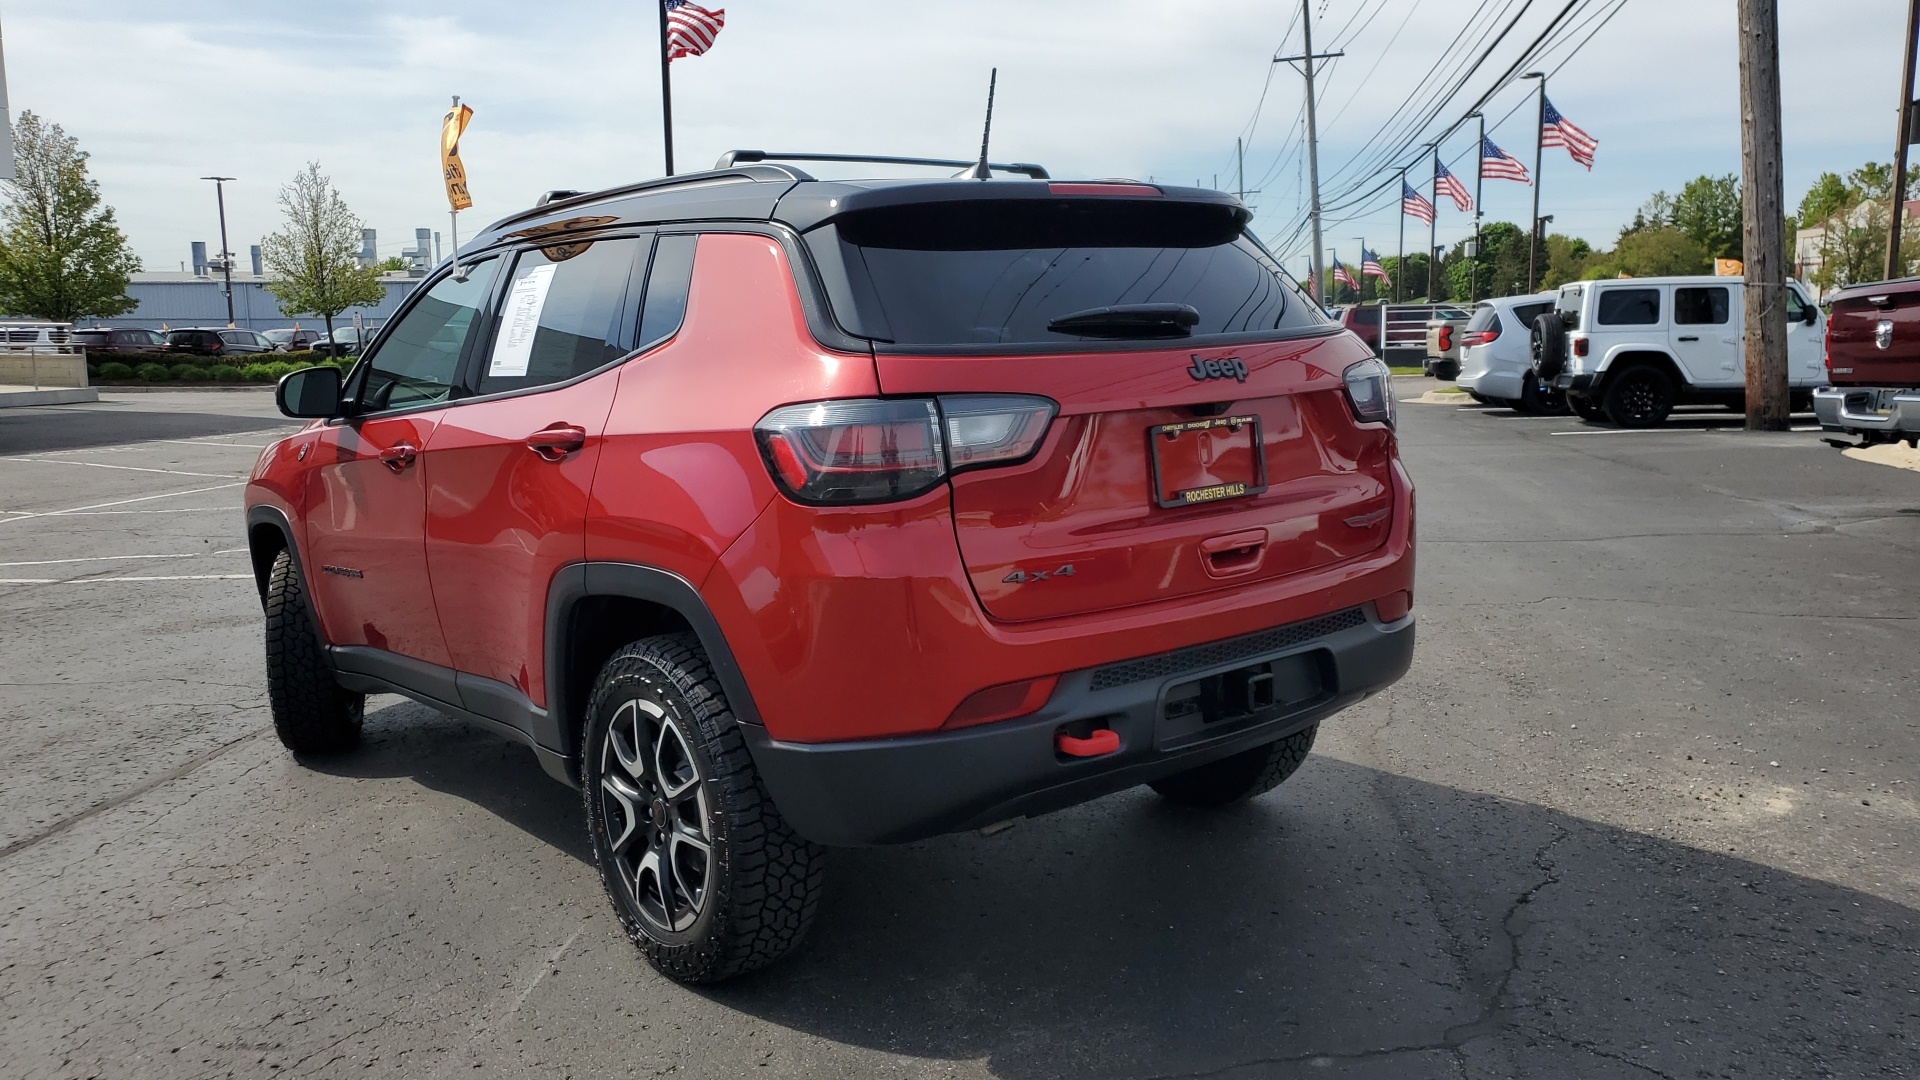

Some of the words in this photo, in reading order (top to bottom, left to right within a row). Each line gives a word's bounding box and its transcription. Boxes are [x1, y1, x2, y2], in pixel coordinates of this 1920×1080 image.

[1186, 354, 1249, 383] Jeep
[1186, 487, 1226, 502] ROCHESTER
[1226, 484, 1244, 495] HILLS
